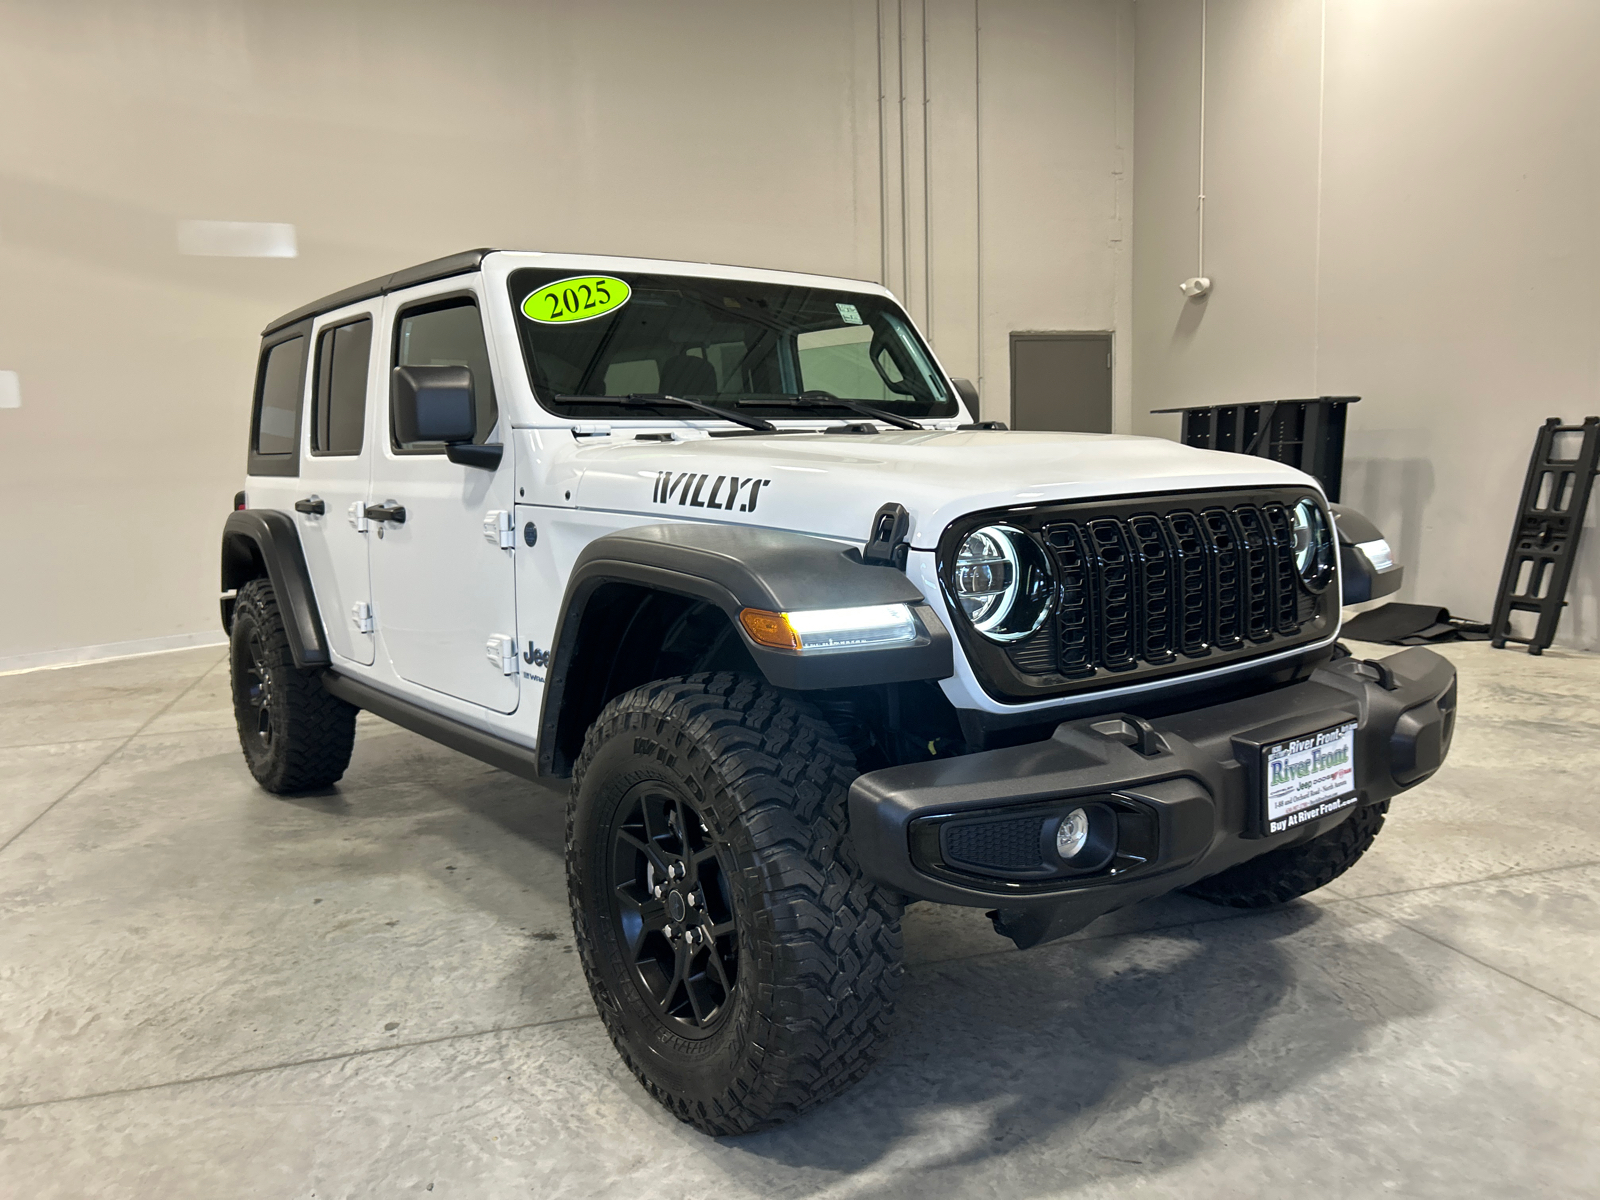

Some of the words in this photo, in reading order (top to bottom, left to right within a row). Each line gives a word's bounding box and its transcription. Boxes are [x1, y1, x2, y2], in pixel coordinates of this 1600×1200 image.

[544, 280, 611, 319] 2025
[653, 471, 771, 512] WILLYS
[523, 640, 550, 668] Jee
[1289, 738, 1315, 755] River
[1316, 729, 1340, 746] Front
[1270, 758, 1311, 786] River
[1311, 744, 1349, 773] Front
[1296, 781, 1313, 792] Jeep
[1270, 820, 1287, 833] Buy
[1288, 815, 1298, 827] At
[1298, 808, 1320, 822] River
